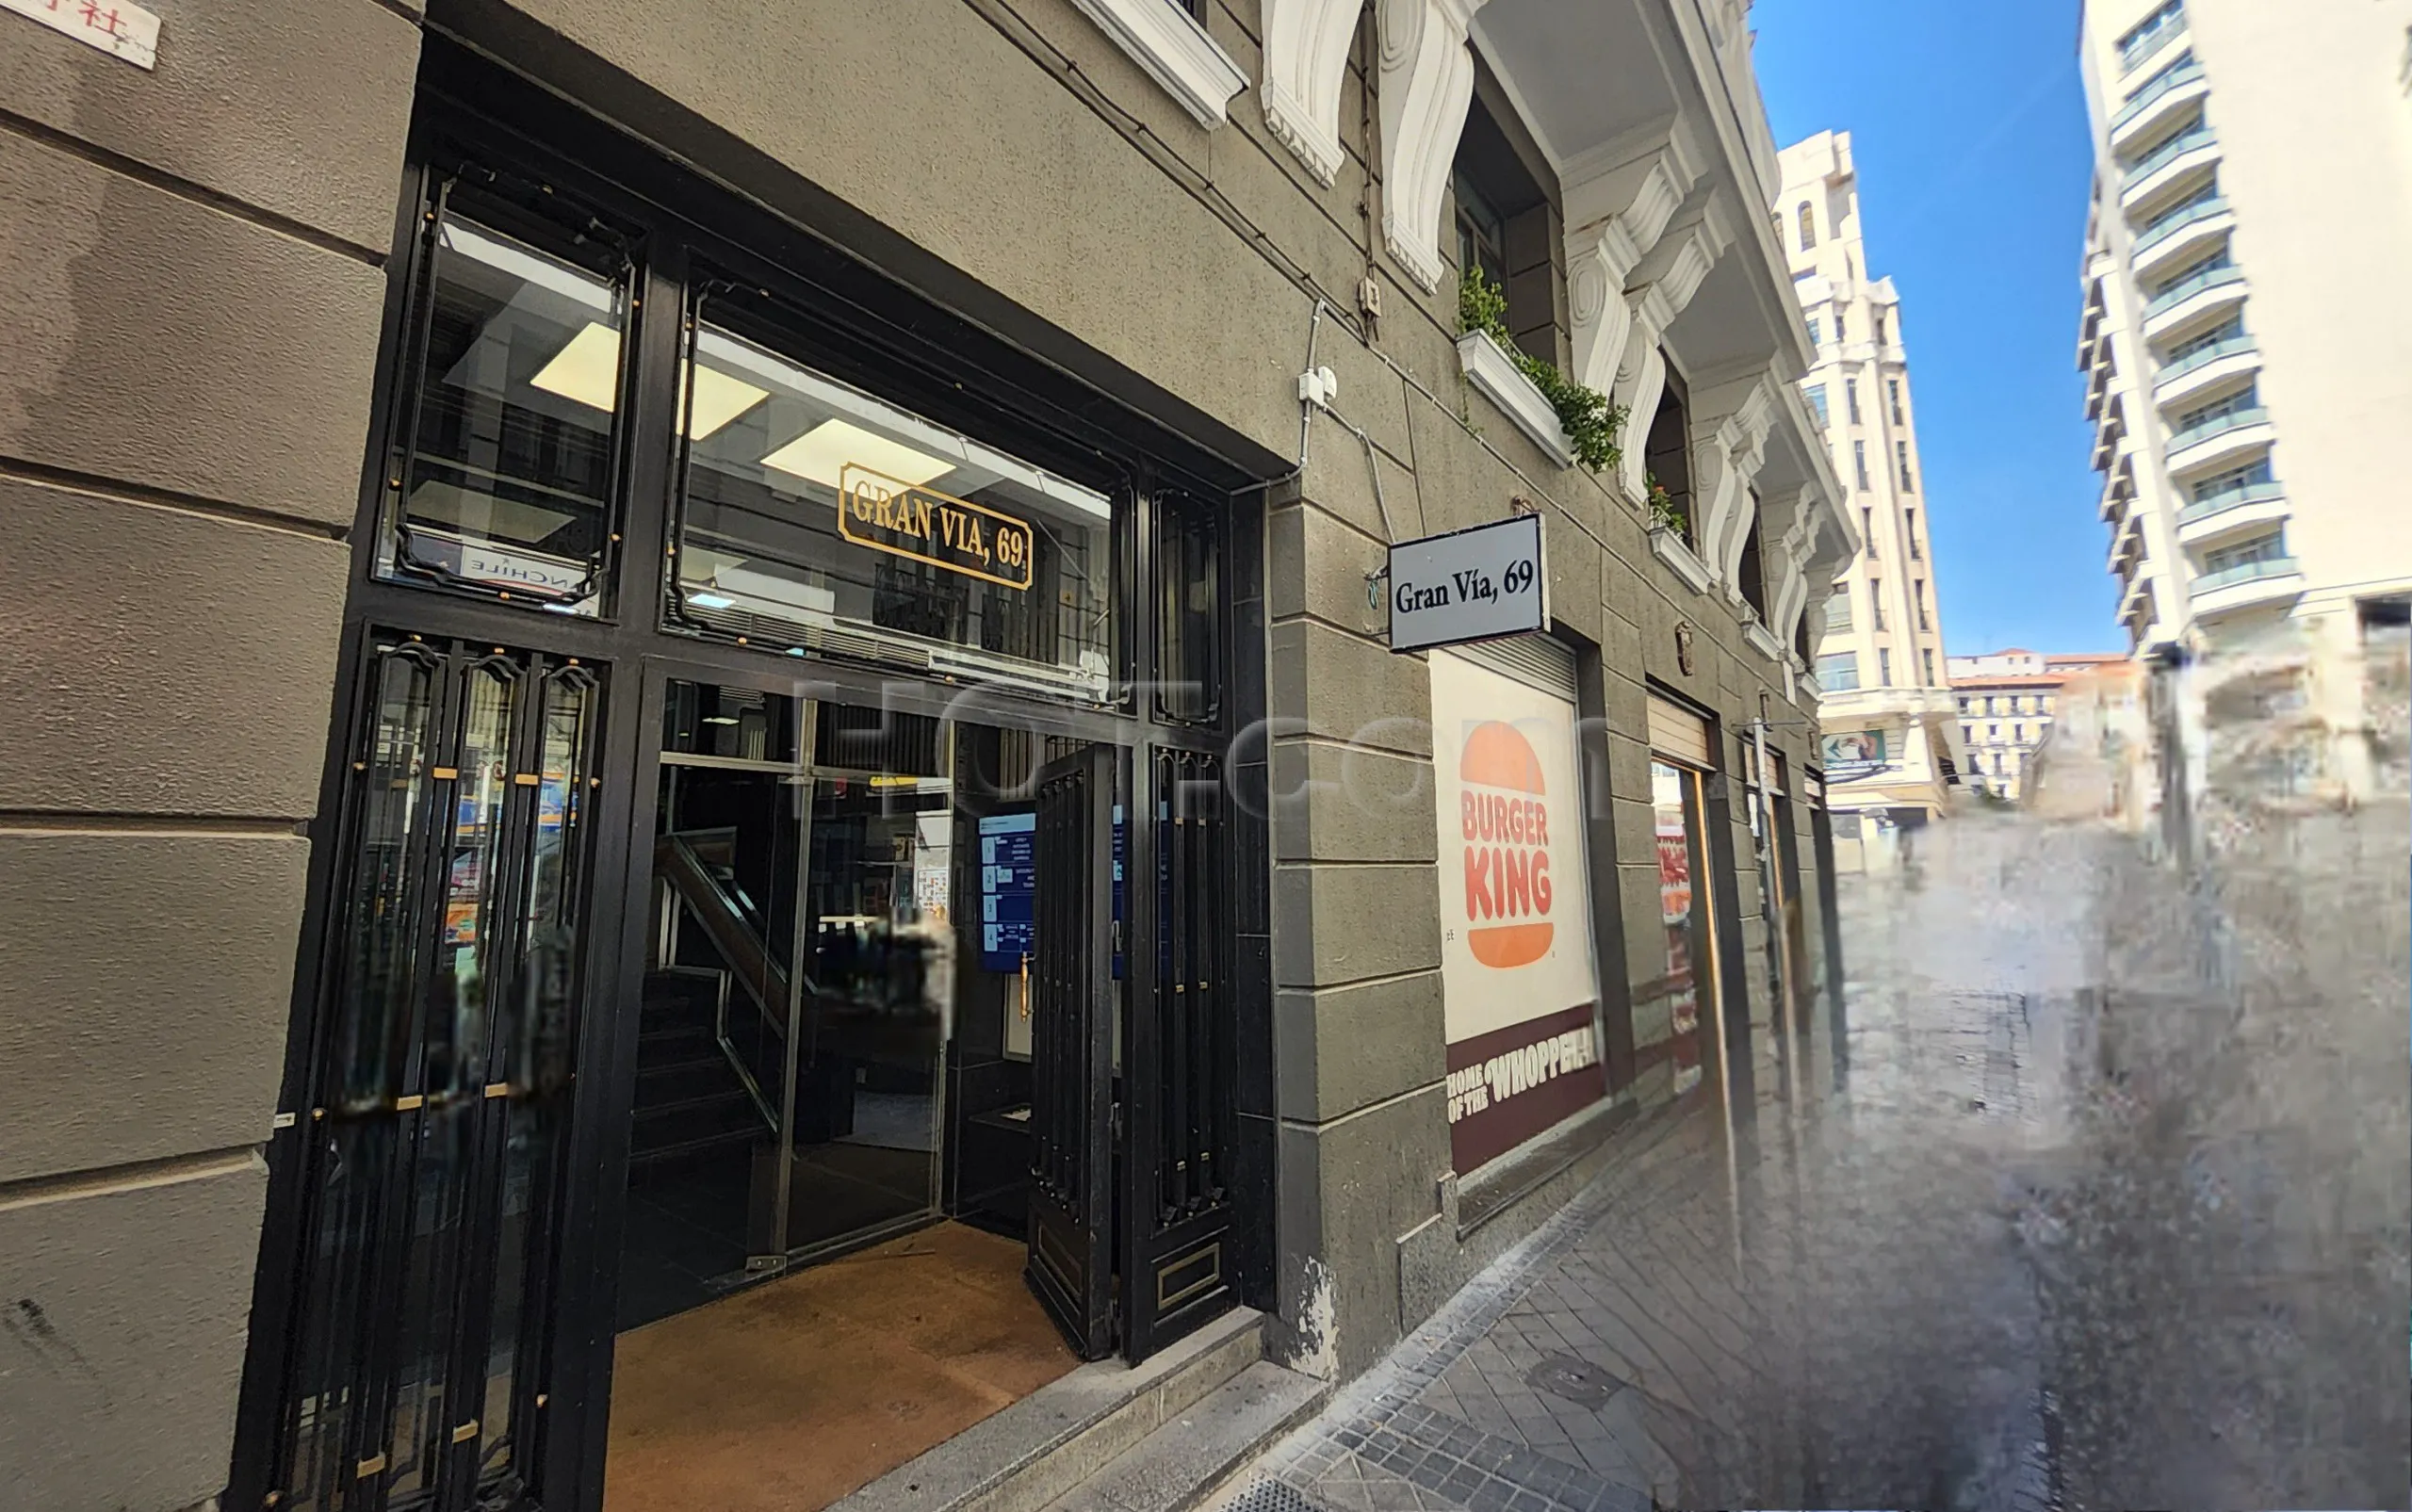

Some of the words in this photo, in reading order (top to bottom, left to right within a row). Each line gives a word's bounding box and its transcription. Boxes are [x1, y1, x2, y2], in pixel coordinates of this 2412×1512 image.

[45, 0, 130, 41] 社
[852, 480, 934, 542] GRAN
[938, 506, 991, 567] VIA,
[996, 526, 1024, 568] 69
[1395, 581, 1450, 614] Gran
[1451, 568, 1499, 605] Vía,
[1503, 559, 1534, 594] 69
[1460, 789, 1549, 847] BURGER
[1463, 845, 1553, 922] KING
[1445, 1063, 1485, 1099] HOME
[1484, 1027, 1596, 1103] WHOPPE
[1447, 1095, 1464, 1125] OF
[1464, 1085, 1490, 1116] THE
